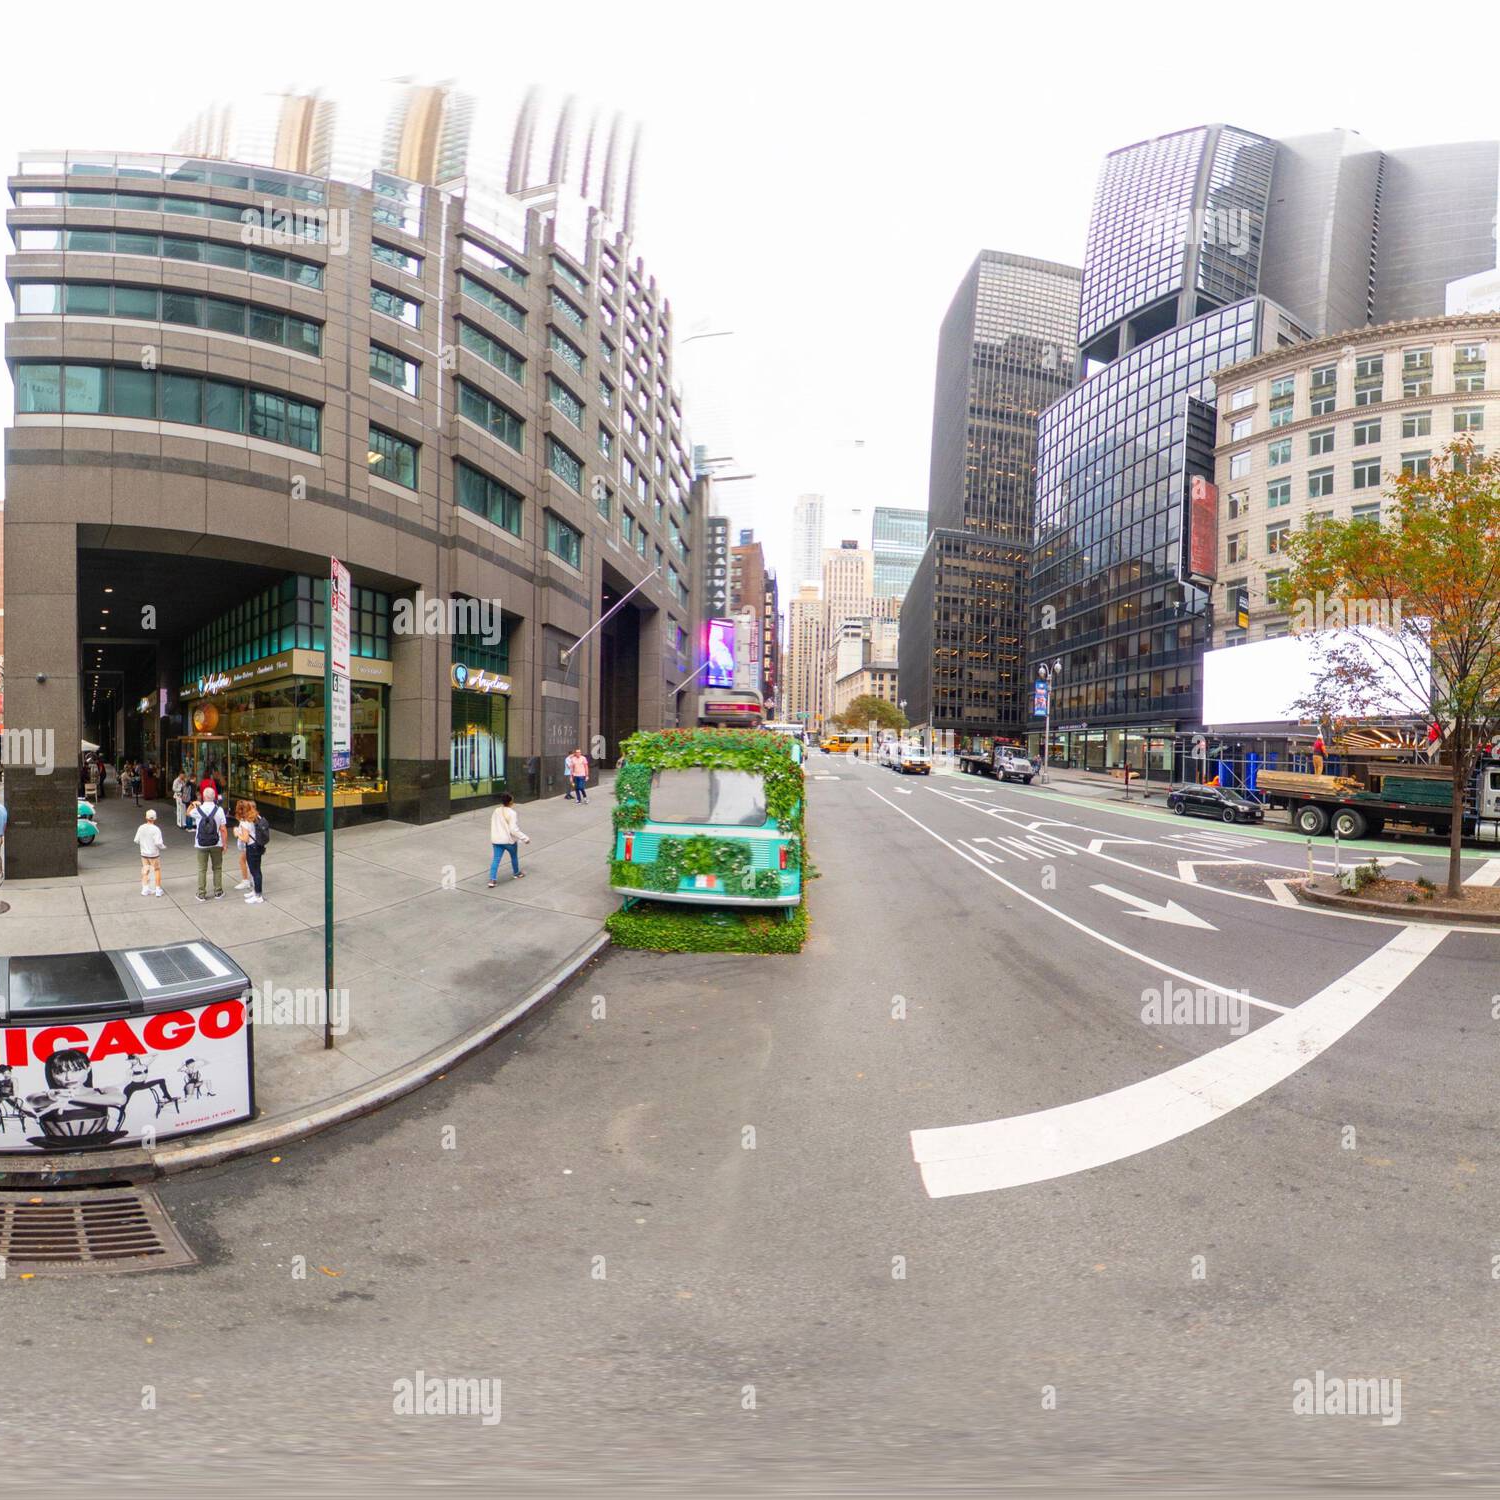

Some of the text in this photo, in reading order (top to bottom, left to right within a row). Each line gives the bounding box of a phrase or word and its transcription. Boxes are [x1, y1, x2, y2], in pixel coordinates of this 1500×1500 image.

[715, 526, 726, 610] BROADWAY
[552, 724, 573, 736] 1675
[957, 834, 1078, 864] ONLY
